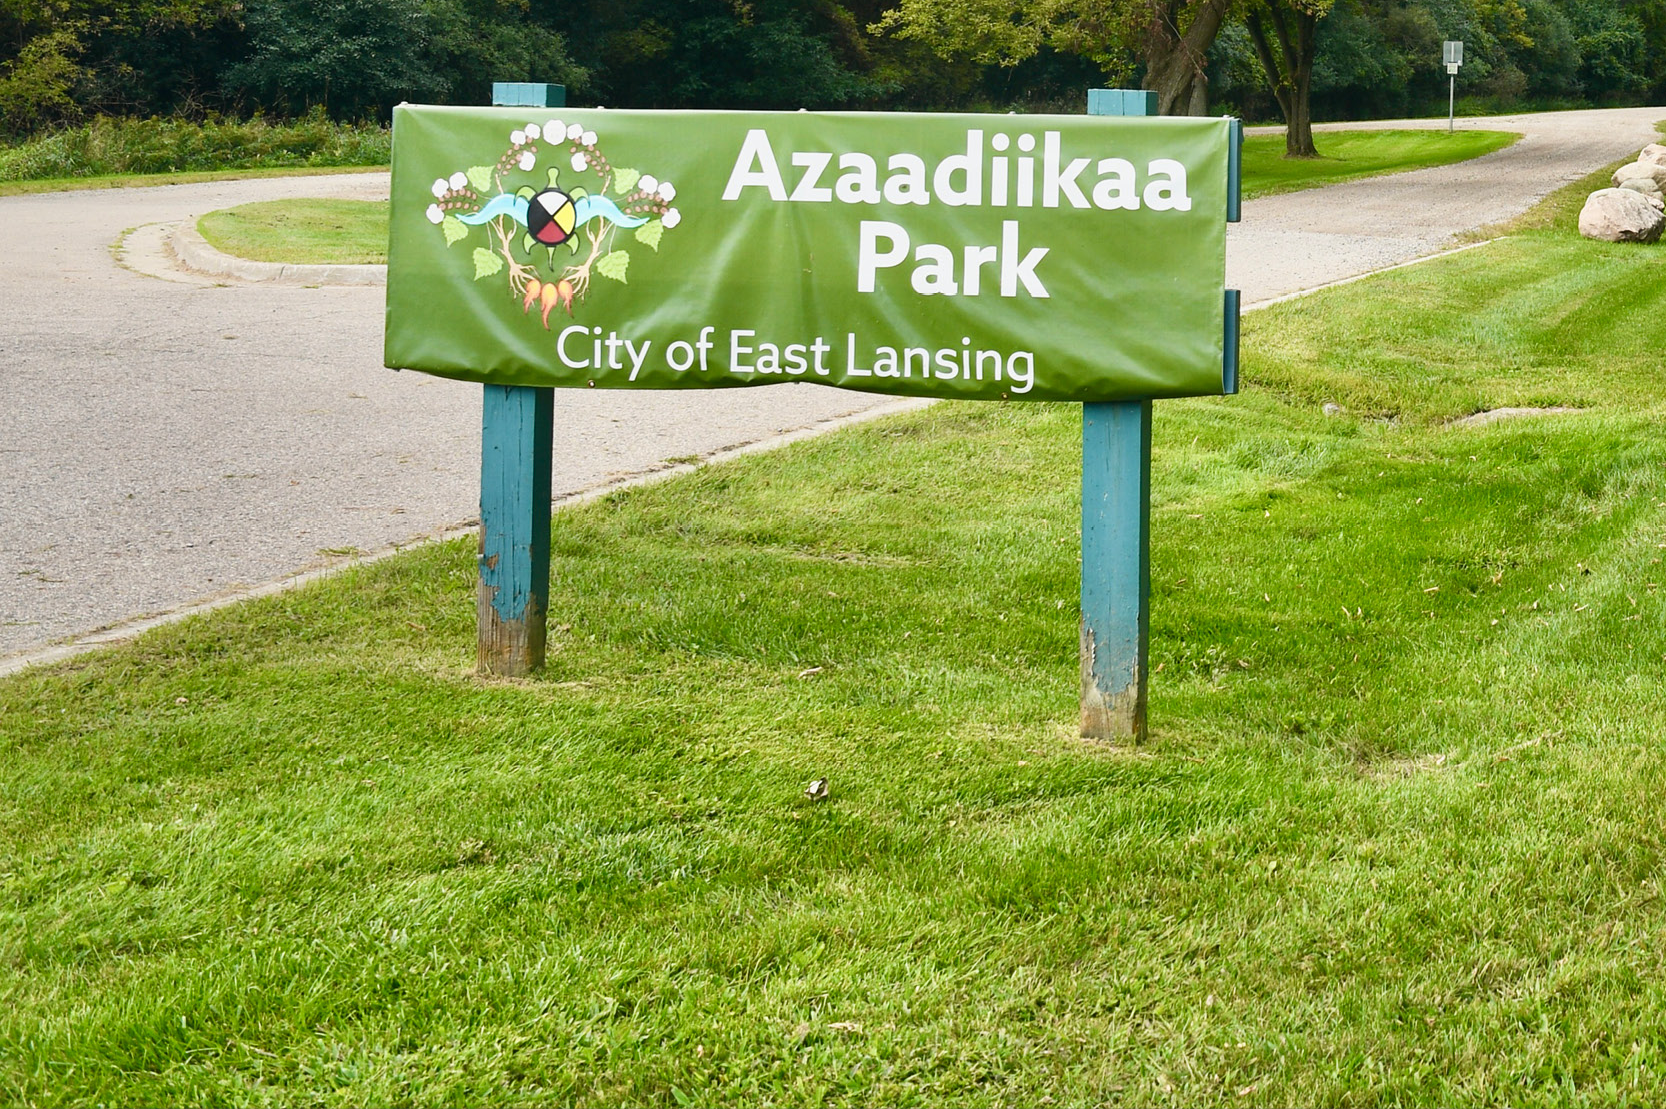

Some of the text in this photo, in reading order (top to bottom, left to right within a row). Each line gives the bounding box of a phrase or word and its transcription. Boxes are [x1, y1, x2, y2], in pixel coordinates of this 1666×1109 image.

[721, 128, 1192, 212] Azaadiikaa
[857, 220, 1050, 299] Park
[557, 325, 1035, 394] City of East Lansing
